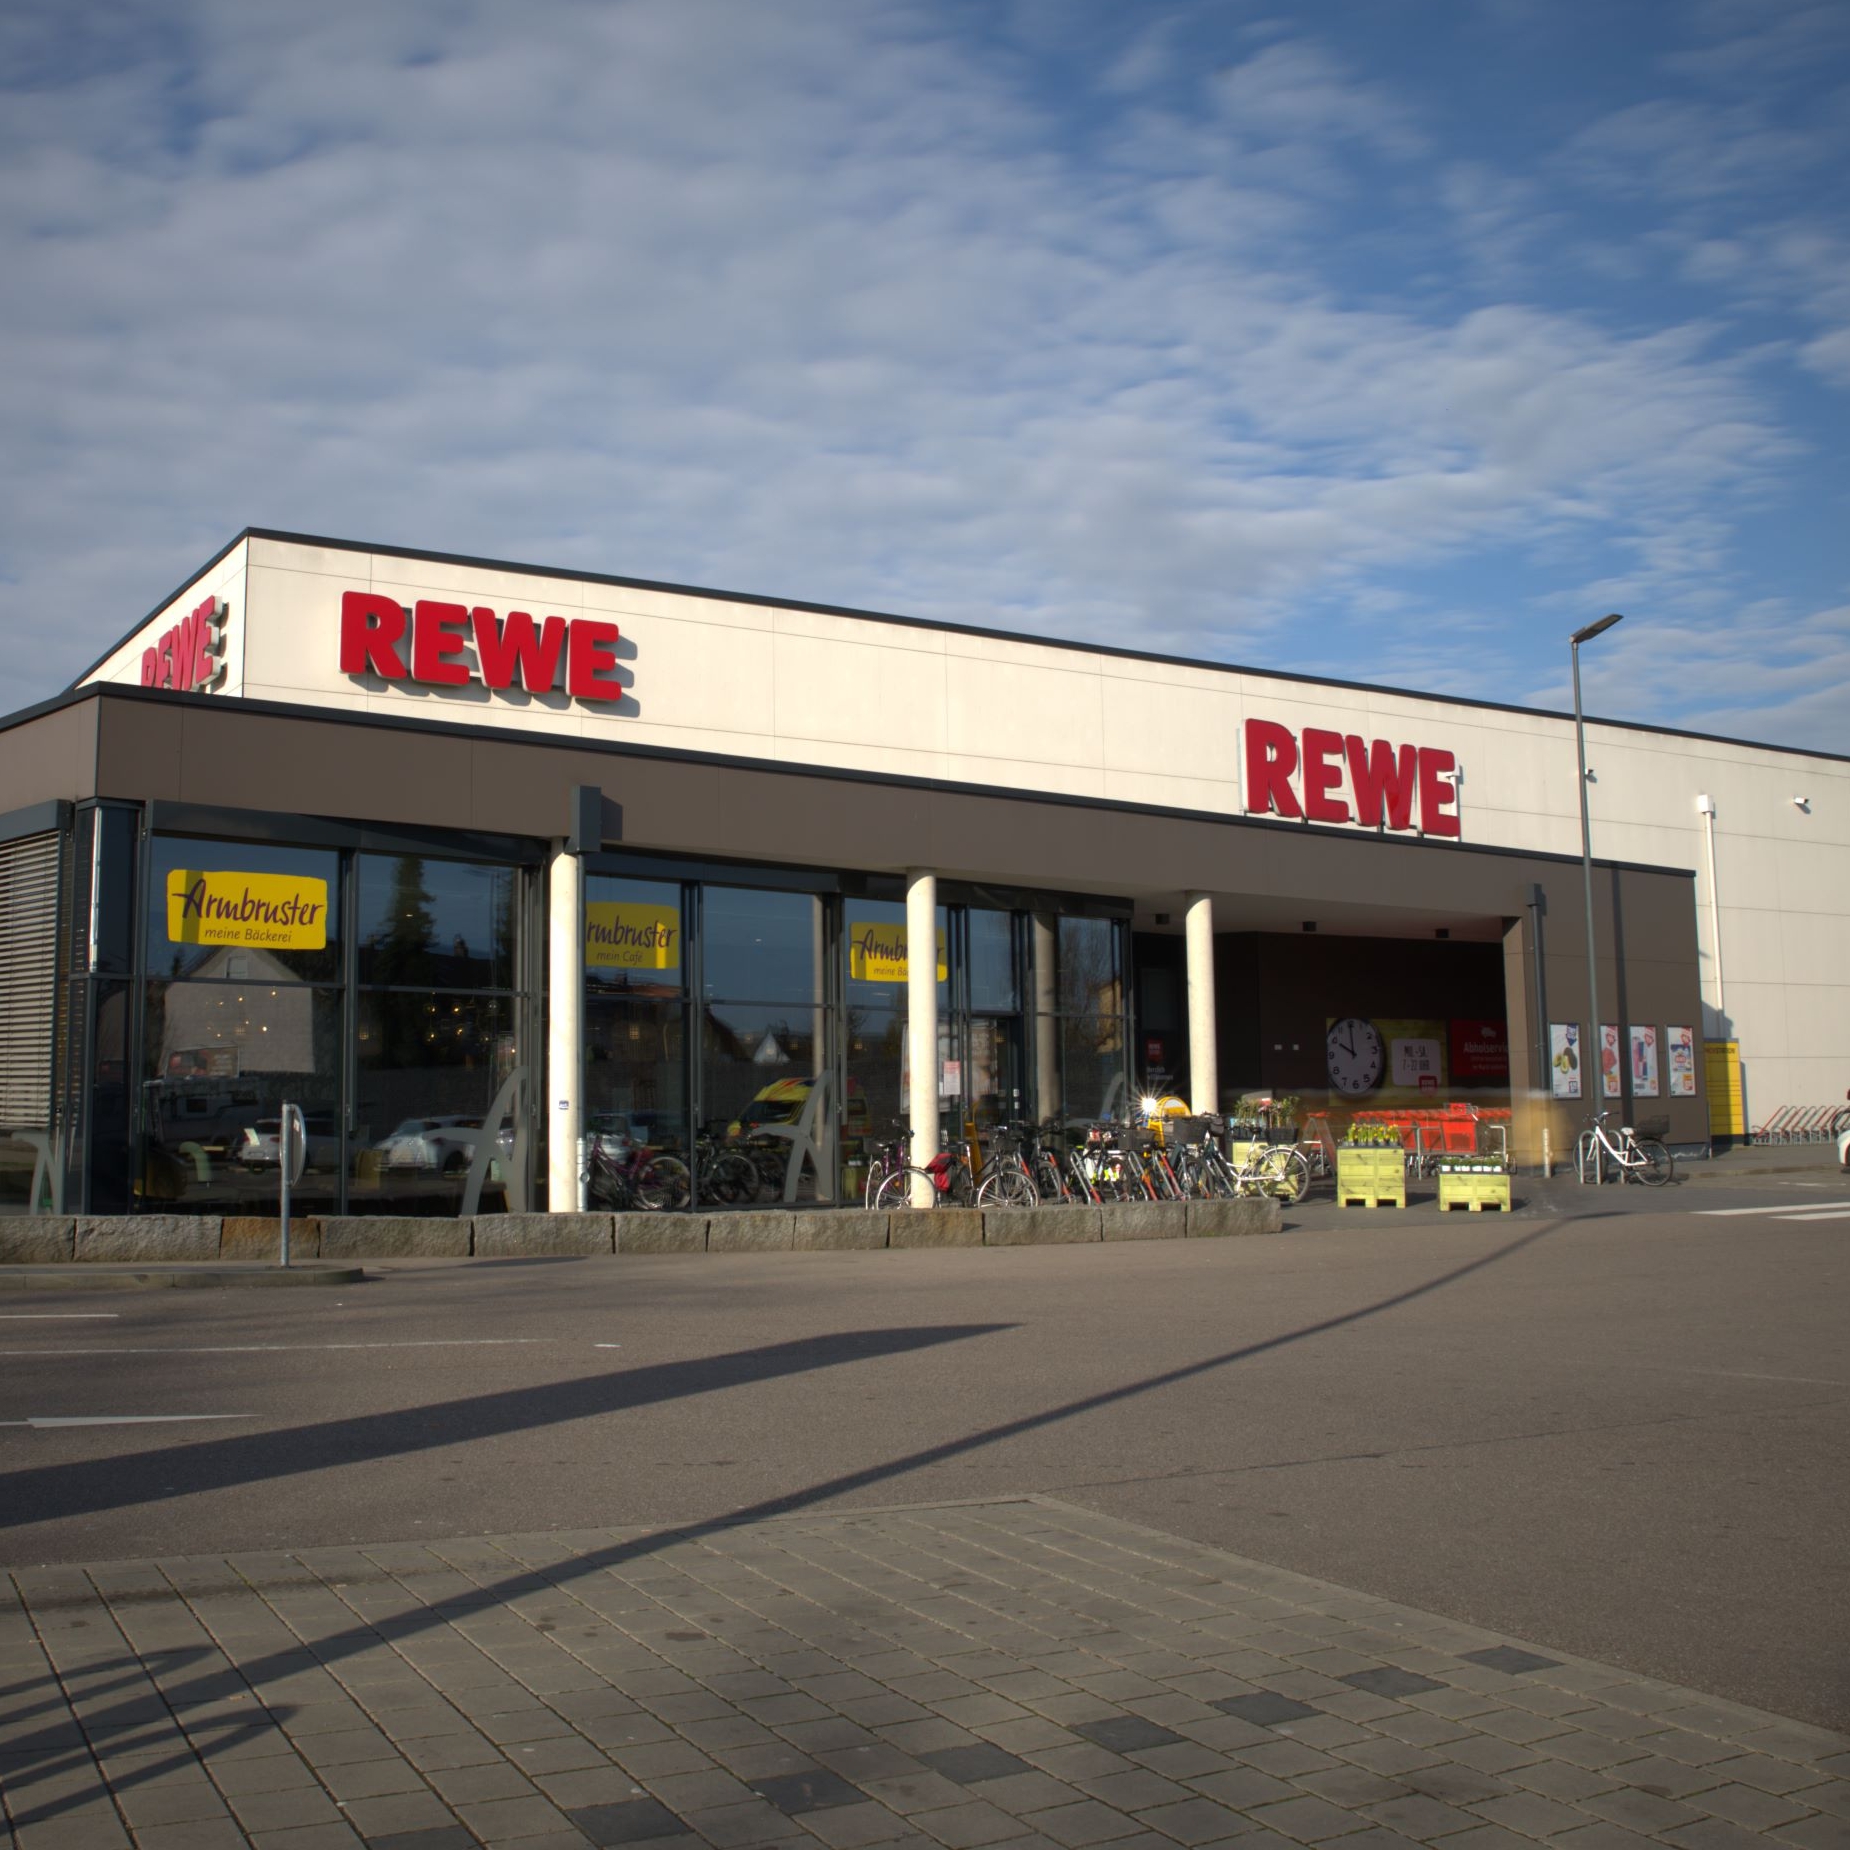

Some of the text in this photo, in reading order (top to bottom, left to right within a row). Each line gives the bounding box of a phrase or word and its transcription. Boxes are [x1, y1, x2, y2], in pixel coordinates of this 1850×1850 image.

[340, 590, 623, 701] REWE
[1245, 718, 1461, 838] REWE
[172, 878, 324, 926] Armbruster
[204, 927, 293, 943] meine Bäckerei
[586, 915, 678, 948] rmbruster
[597, 949, 620, 961] mein
[873, 965, 896, 977] meine
[1352, 1080, 1360, 1089] 6
